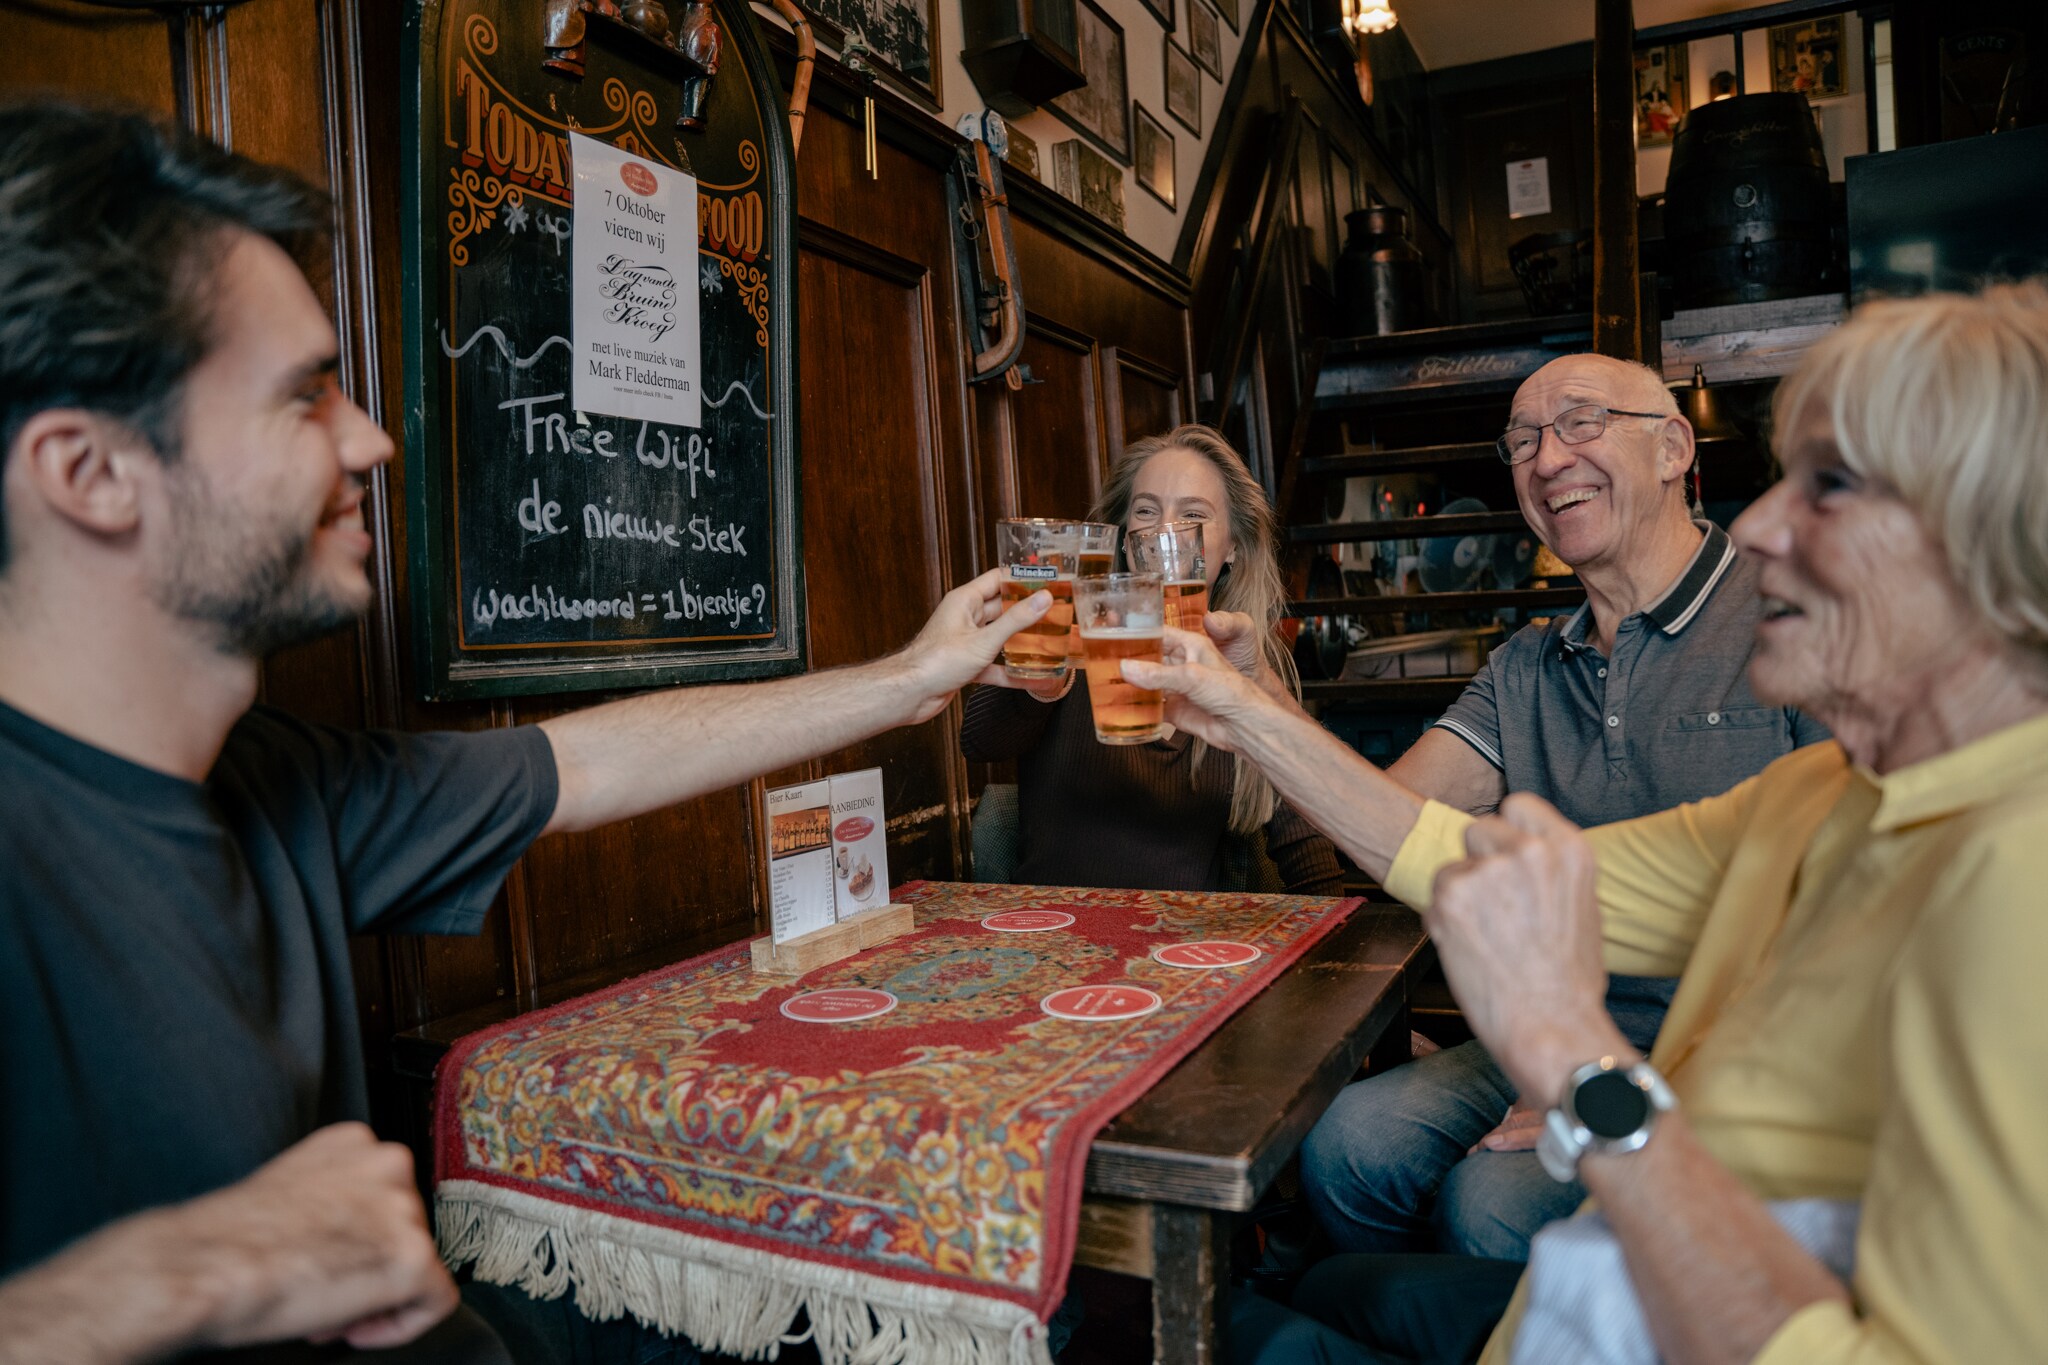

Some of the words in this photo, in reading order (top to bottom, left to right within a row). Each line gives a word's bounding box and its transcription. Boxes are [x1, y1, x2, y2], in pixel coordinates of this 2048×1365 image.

[604, 189, 612, 207] 7
[616, 194, 666, 224] Oktober
[604, 218, 643, 243] vieren
[646, 232, 665, 254] wij
[598, 277, 677, 311] Bruine
[603, 300, 677, 343] Kroeg
[592, 342, 611, 355] met
[613, 342, 632, 359] live
[634, 350, 668, 366] muziek
[669, 357, 686, 369] van
[589, 360, 622, 380] Mark
[625, 366, 690, 391] Fledderman
[518, 478, 569, 534] de
[1012, 566, 1056, 578] Heineken
[769, 793, 784, 804] Bier
[785, 790, 803, 801] Kaart
[831, 796, 876, 814] AANBIEDING
